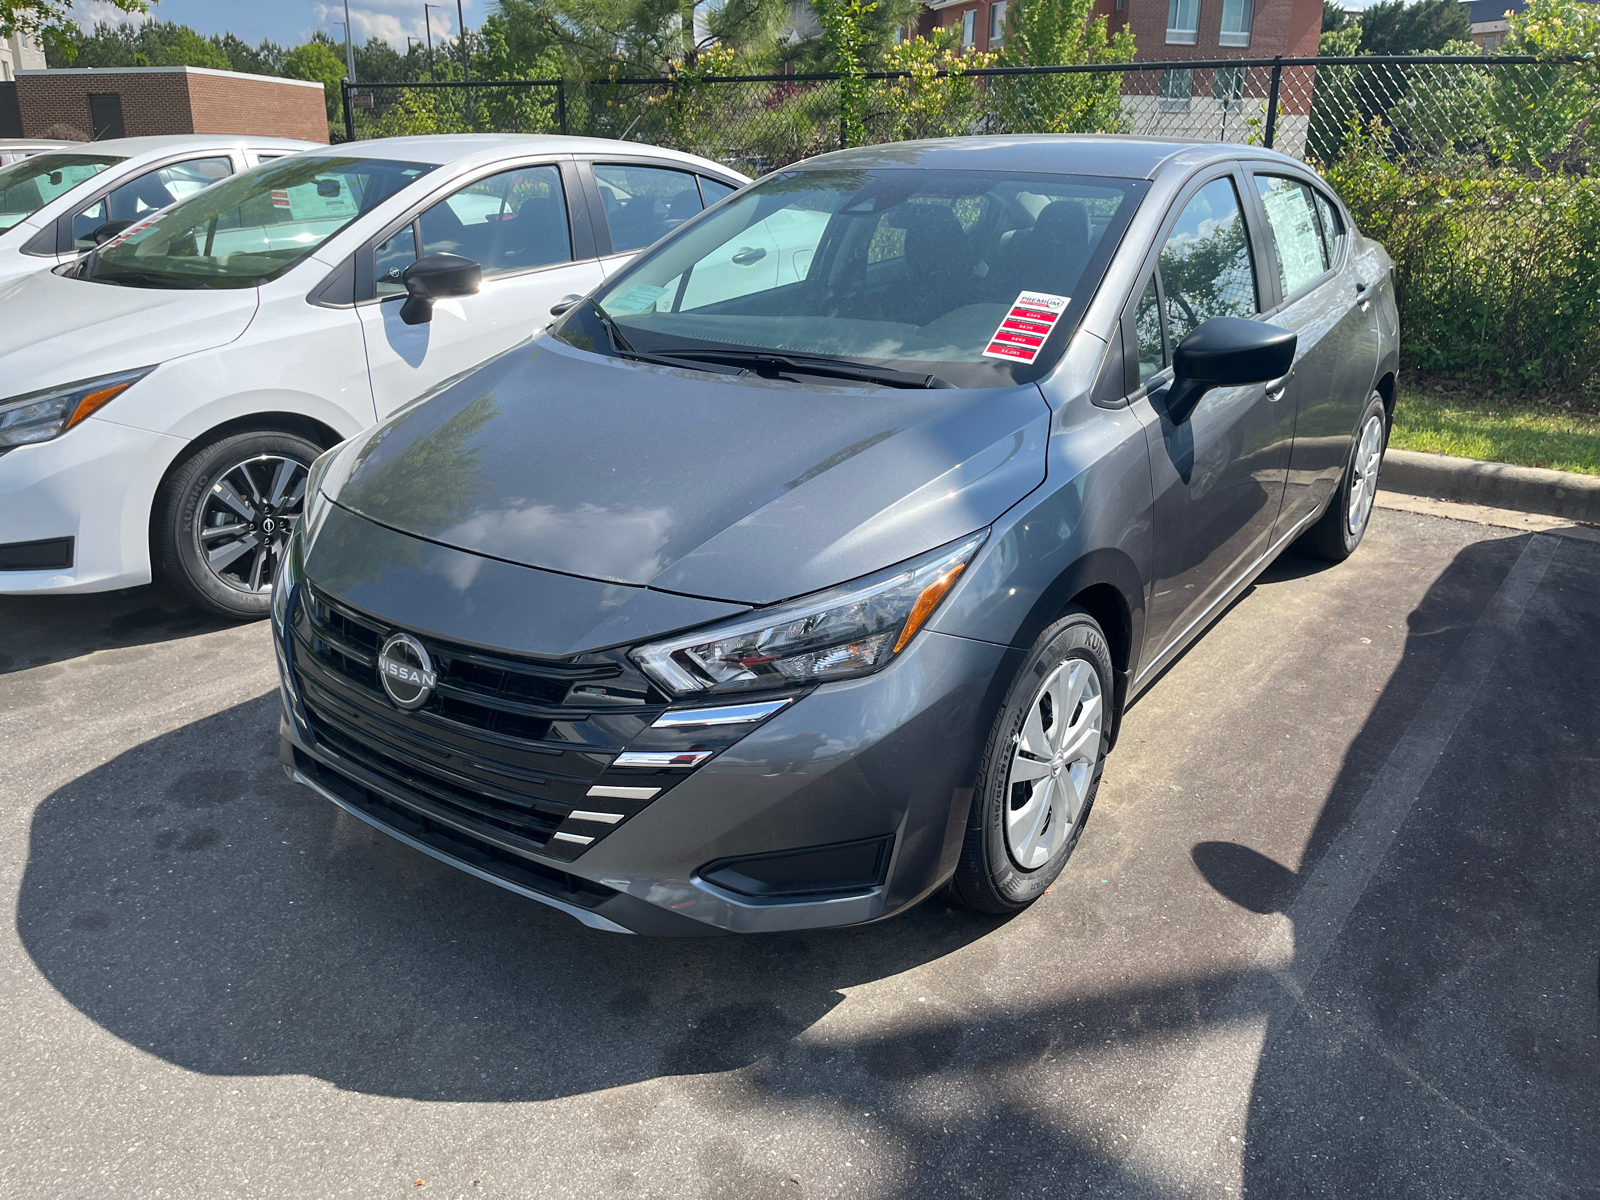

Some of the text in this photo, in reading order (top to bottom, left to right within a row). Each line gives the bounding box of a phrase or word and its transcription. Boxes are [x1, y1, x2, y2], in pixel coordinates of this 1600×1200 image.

[1021, 296, 1061, 306] PREMIUM
[183, 475, 209, 531] KUMHO
[378, 656, 435, 686] NISSAN
[1085, 631, 1112, 681] KUMHO
